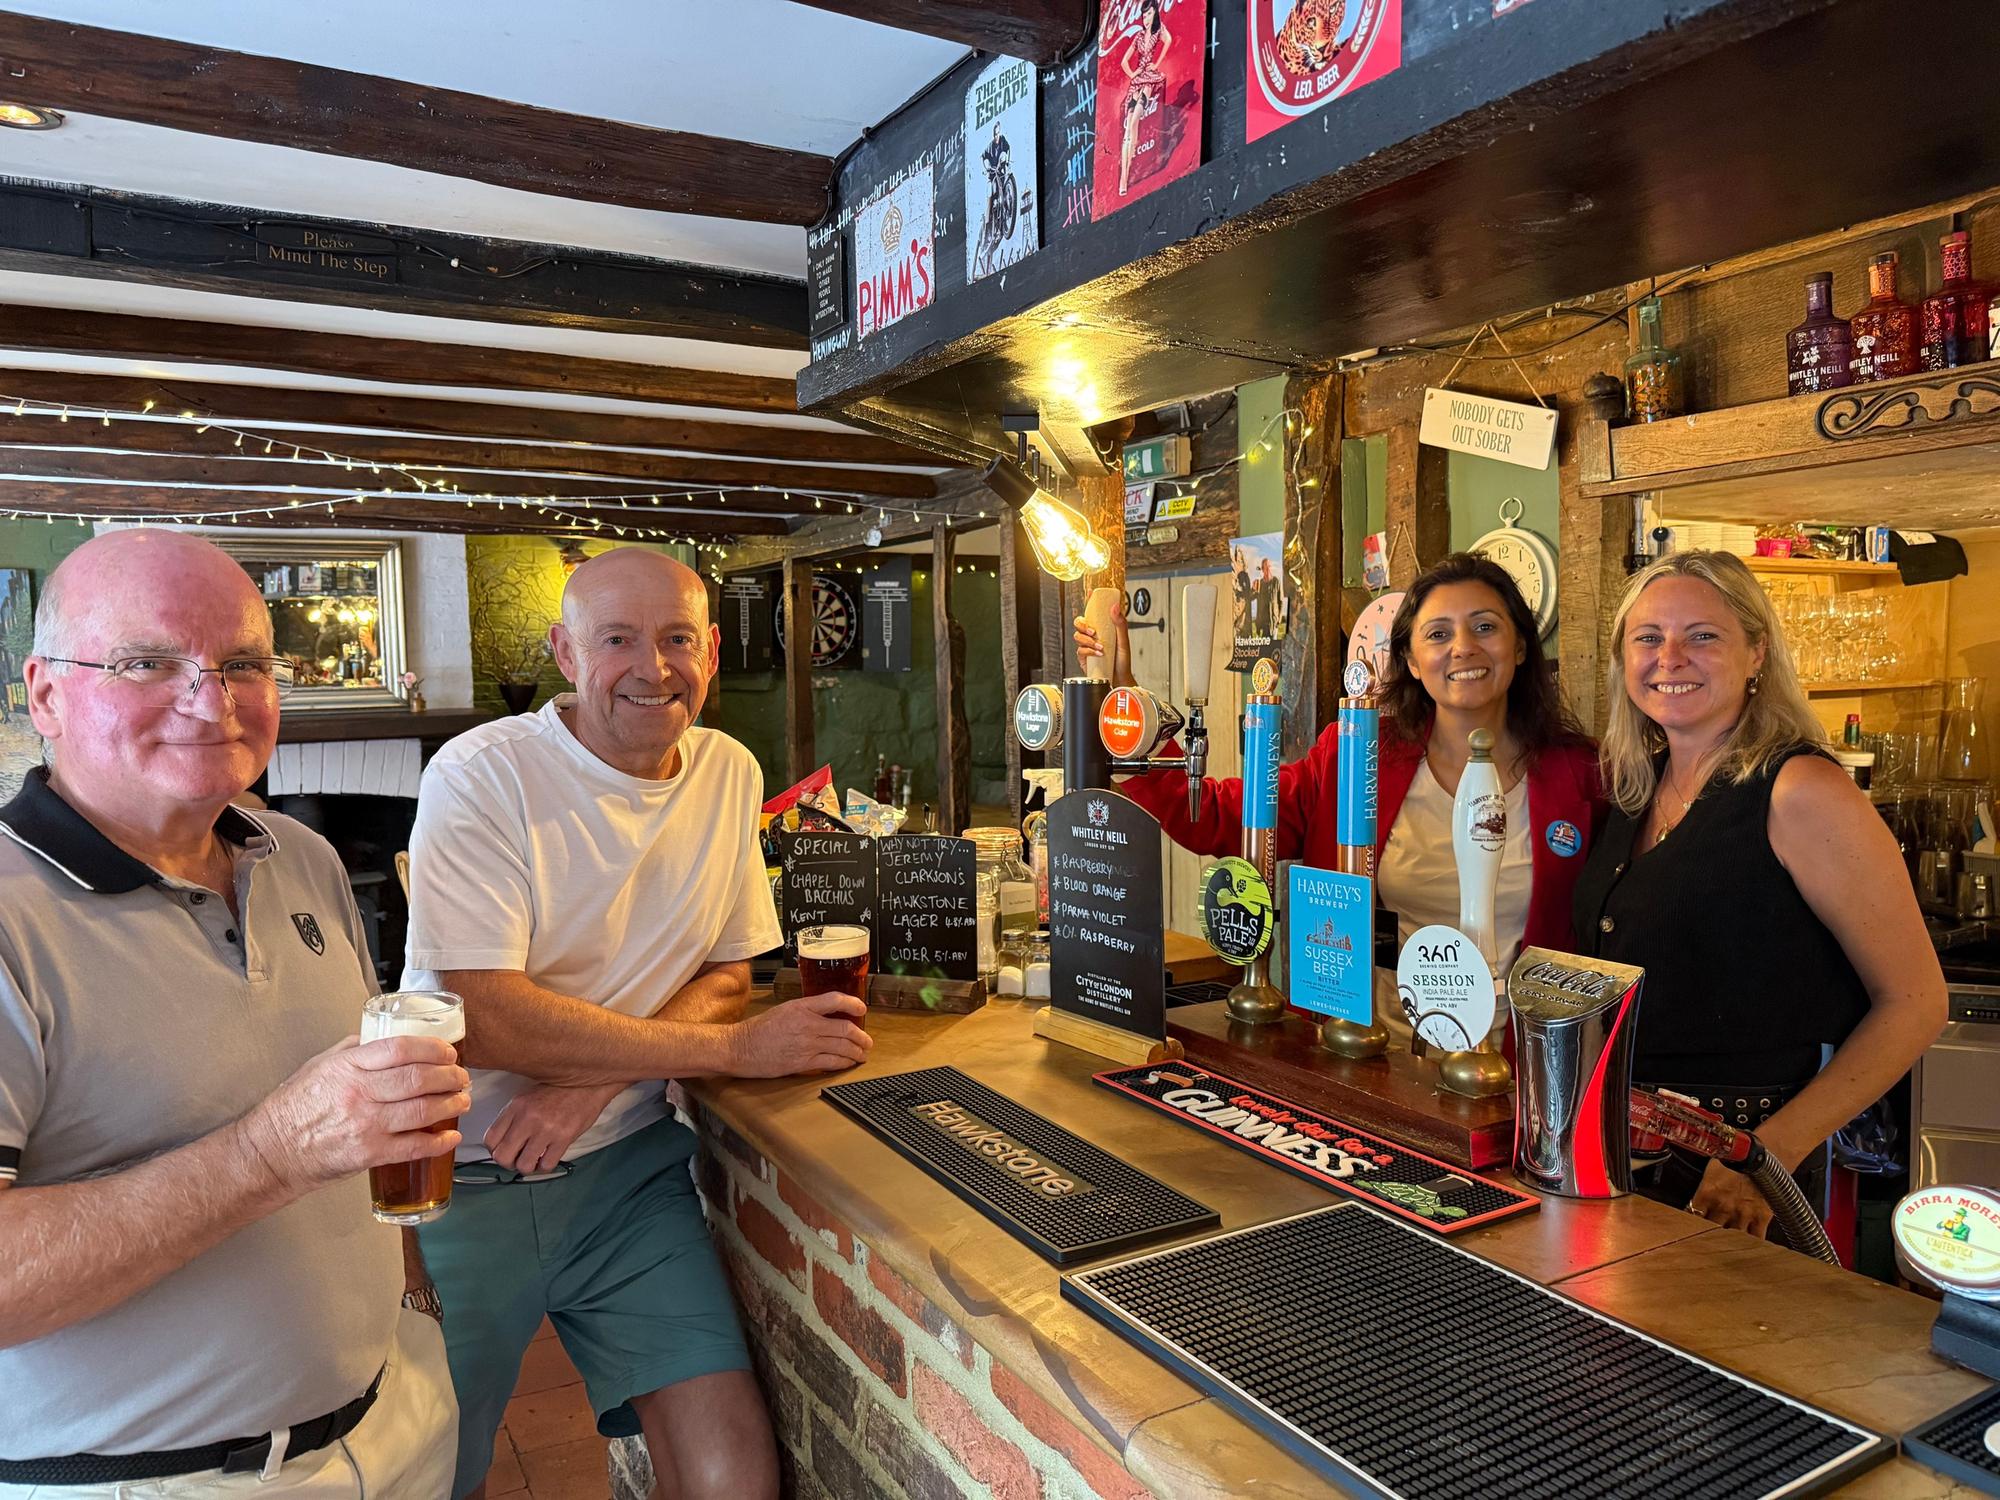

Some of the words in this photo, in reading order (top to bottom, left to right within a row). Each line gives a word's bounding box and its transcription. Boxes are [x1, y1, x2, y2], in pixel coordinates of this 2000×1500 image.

[976, 77, 996, 103] THE
[999, 61, 1028, 90] GREAT
[1317, 64, 1340, 93] BEER
[976, 75, 1028, 131] ESCAPE
[1137, 139, 1155, 155] COLD
[269, 246, 311, 264] Mind
[317, 252, 348, 269] The
[353, 257, 388, 278] Step
[859, 239, 930, 336] PIMM'S
[1874, 352, 1900, 364] NEILL
[1820, 364, 1843, 375] NEILL
[1860, 364, 1874, 375] GIN
[1804, 375, 1820, 386] GIN
[1450, 399, 1494, 425] NOBODY
[1496, 408, 1525, 432] GETS
[1452, 424, 1474, 446] OUT
[1475, 430, 1512, 454] SOBER
[1235, 635, 1271, 647] Hawkstone
[1234, 646, 1260, 658] Stocked
[1231, 659, 1248, 669] Here
[1266, 732, 1280, 805] HARVEY'S
[1365, 739, 1379, 819] HARVEY'S
[880, 838, 904, 852] WHY
[906, 838, 930, 850] NOT
[1071, 826, 1104, 841] WHITLEY
[1106, 831, 1128, 845] NEILL
[794, 838, 851, 855] SPECIAL
[885, 851, 944, 868] JEREMY
[1062, 853, 1112, 879] RASPBERRY
[791, 873, 833, 889] CHAPEL
[839, 874, 865, 889] DOWN
[1063, 876, 1088, 893] BLOOD
[1092, 884, 1128, 901] ORANGE
[1297, 877, 1361, 902] HARVEY'S
[804, 888, 855, 905] BACCHUS
[881, 891, 968, 911] HAWKSTONE
[1309, 897, 1349, 910] BREWERY
[790, 908, 827, 924] KENT
[892, 914, 938, 928] LAGER
[1062, 902, 1090, 920] PARMA
[1092, 910, 1126, 926] VIOLET
[1210, 908, 1258, 936] PELLS
[1080, 928, 1135, 954] RASPBERRY
[1219, 927, 1249, 947] PALE
[890, 946, 930, 962] CIDER
[1305, 945, 1353, 968] SUSSEX
[1313, 961, 1344, 979] BEST
[1412, 974, 1475, 986] SESSION
[1076, 974, 1094, 988] CITY
[1100, 982, 1132, 1000] LONDON
[1087, 988, 1121, 1004] DISTILLERY
[1422, 988, 1438, 996] INDIA
[1440, 988, 1455, 996] PALE
[1456, 988, 1468, 996] ALE
[1517, 988, 1546, 1000] ZERO
[1547, 994, 1584, 1009] SUGAR
[1162, 1088, 1379, 1178] GUINNESS
[915, 1100, 1075, 1197] Hawkstone
[1294, 1121, 1339, 1141] day
[1335, 1138, 1376, 1156] for
[1373, 1153, 1394, 1166] a
[1905, 1195, 1953, 1216] BIRRA
